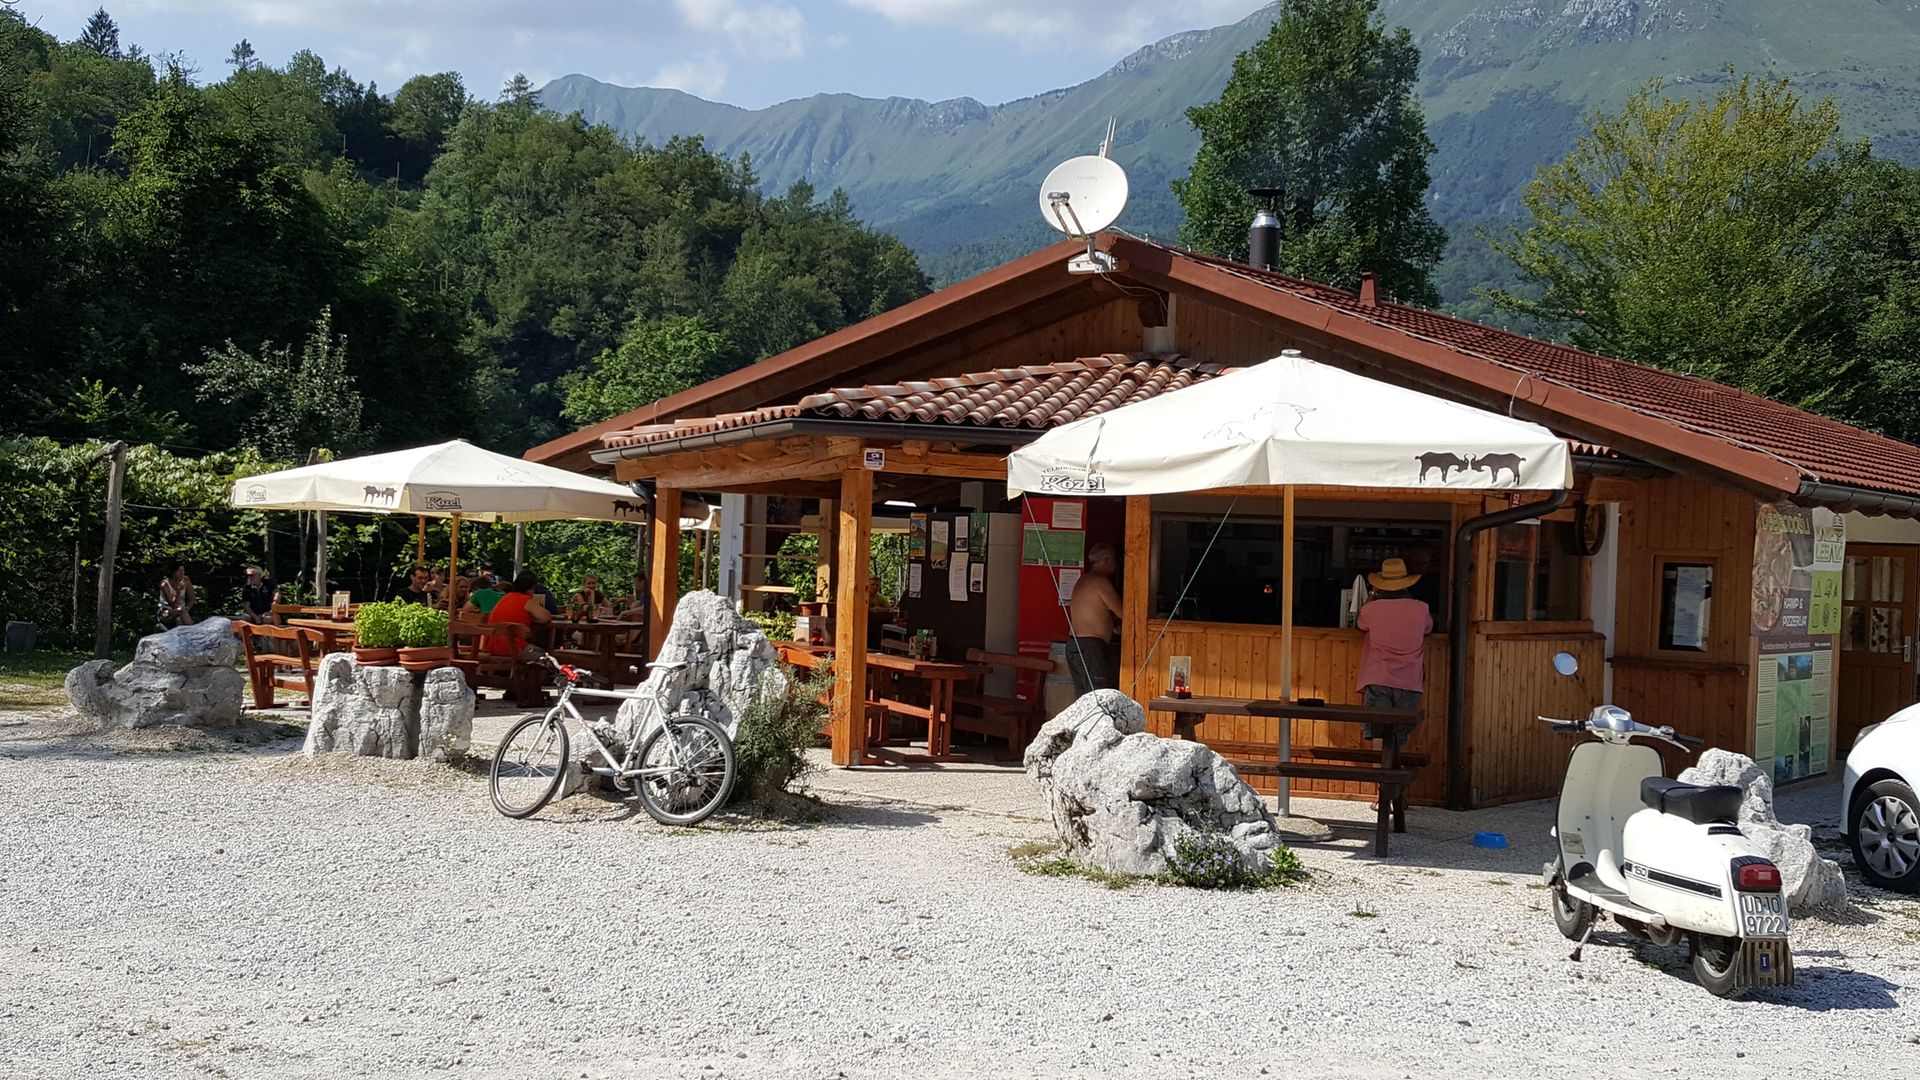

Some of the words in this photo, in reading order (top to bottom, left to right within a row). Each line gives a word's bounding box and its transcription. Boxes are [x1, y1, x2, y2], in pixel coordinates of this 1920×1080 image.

[1040, 475, 1106, 493] Kozel
[424, 496, 462, 510] Kozel
[1633, 865, 1647, 877] 150
[1747, 916, 1784, 934] 9722
